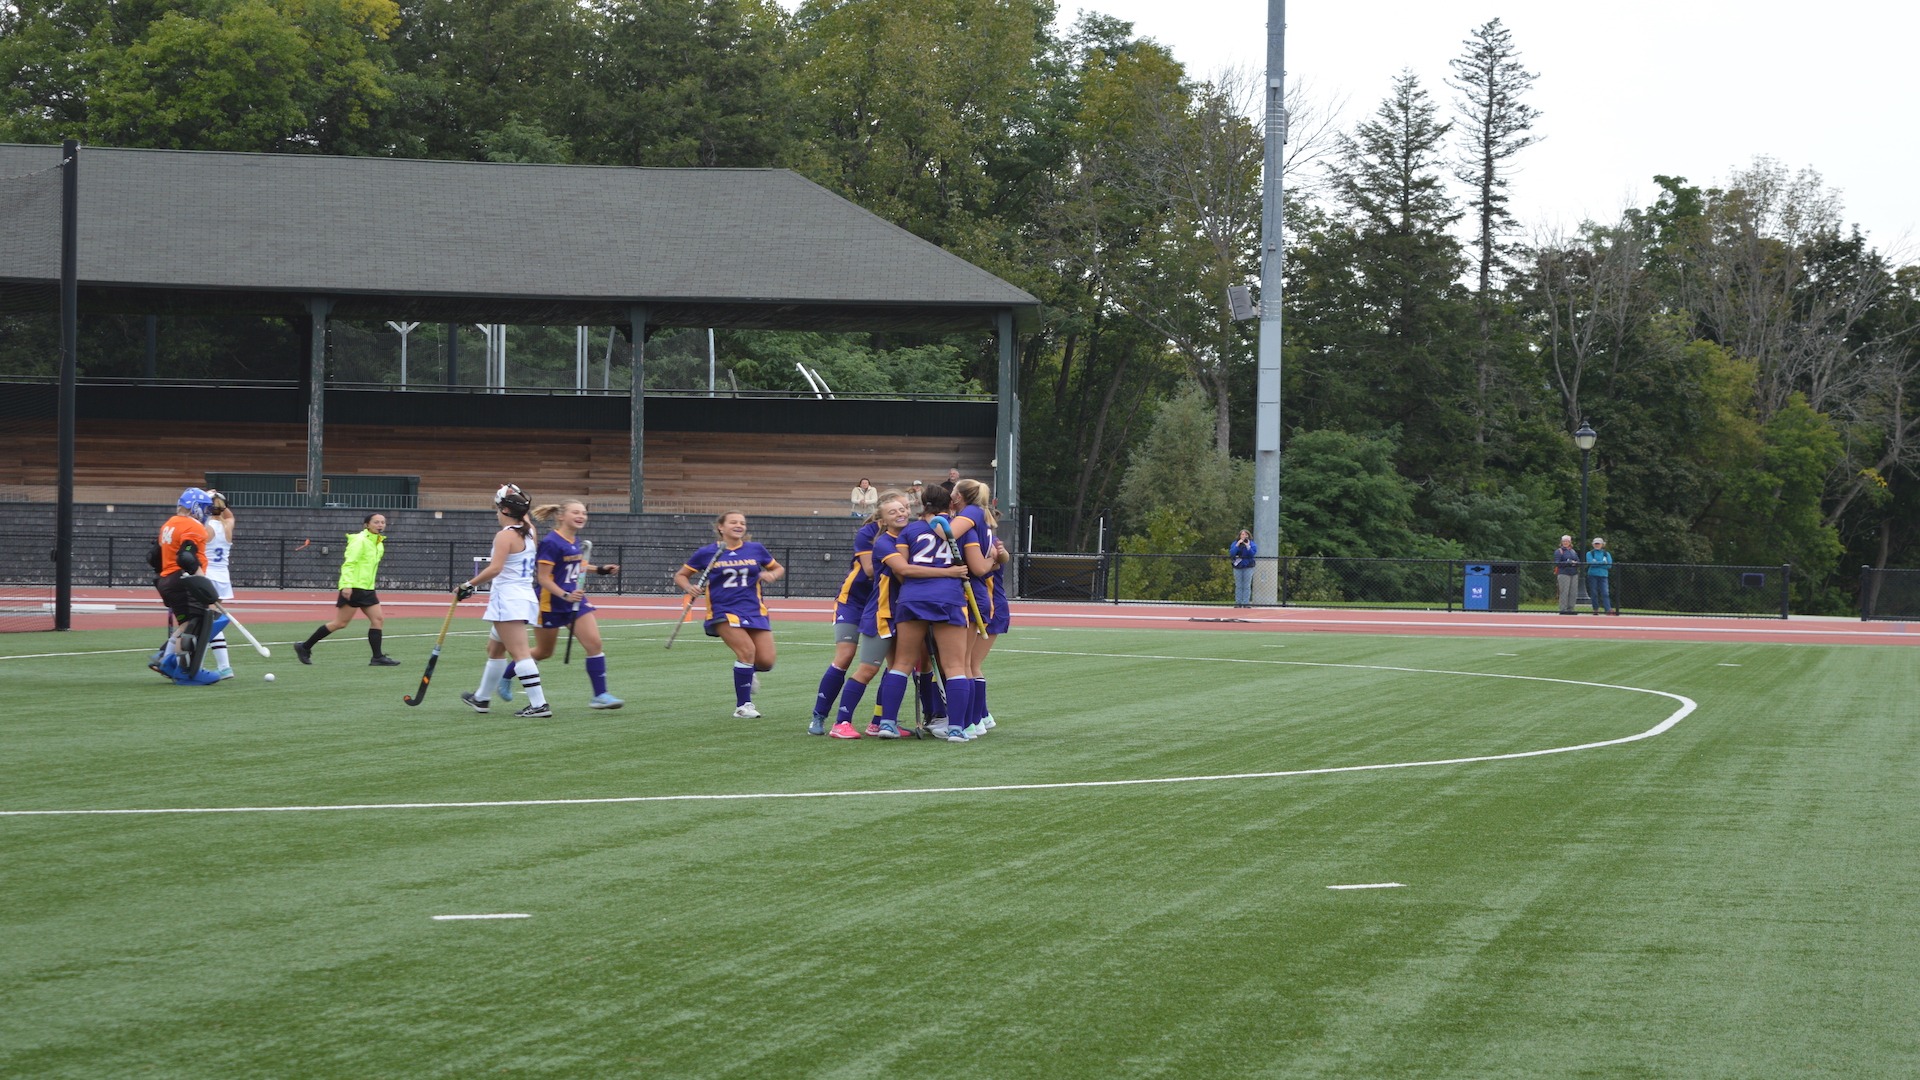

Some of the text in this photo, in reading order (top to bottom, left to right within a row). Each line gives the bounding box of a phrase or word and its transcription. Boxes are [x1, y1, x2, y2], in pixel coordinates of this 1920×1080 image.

[213, 547, 224, 562] 3
[912, 533, 955, 566] 24
[563, 562, 581, 584] 14
[722, 567, 749, 588] 21
